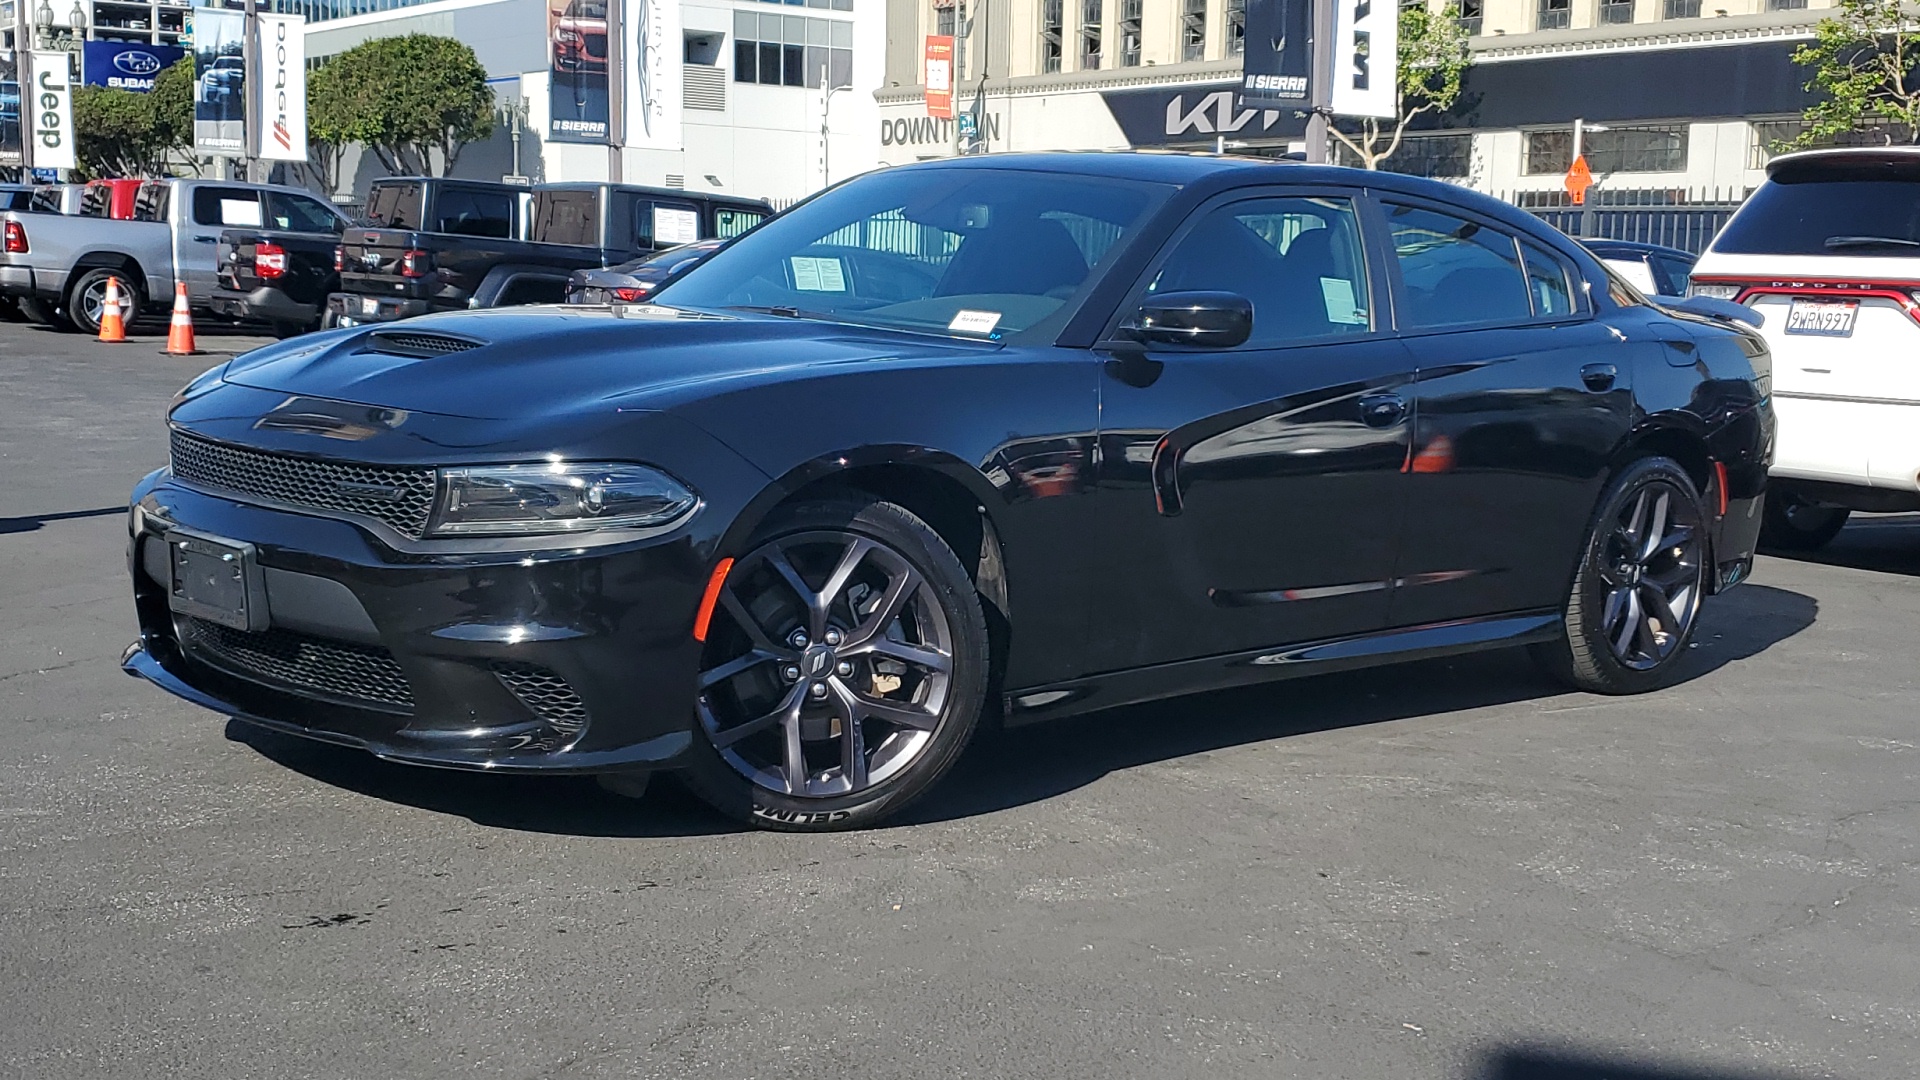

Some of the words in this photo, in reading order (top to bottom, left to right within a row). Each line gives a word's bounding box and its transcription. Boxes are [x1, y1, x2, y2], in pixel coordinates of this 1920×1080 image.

[654, 7, 662, 117] HRYSLER
[107, 76, 155, 89] SUBAR
[276, 22, 287, 134] DODGE
[1255, 75, 1307, 91] SIERRA
[37, 71, 65, 148] Jeep
[561, 120, 606, 132] SIERRA
[881, 112, 1000, 146] DOWNTWN
[1772, 282, 1871, 290] DODGE
[1790, 311, 1850, 331] 9WRN997
